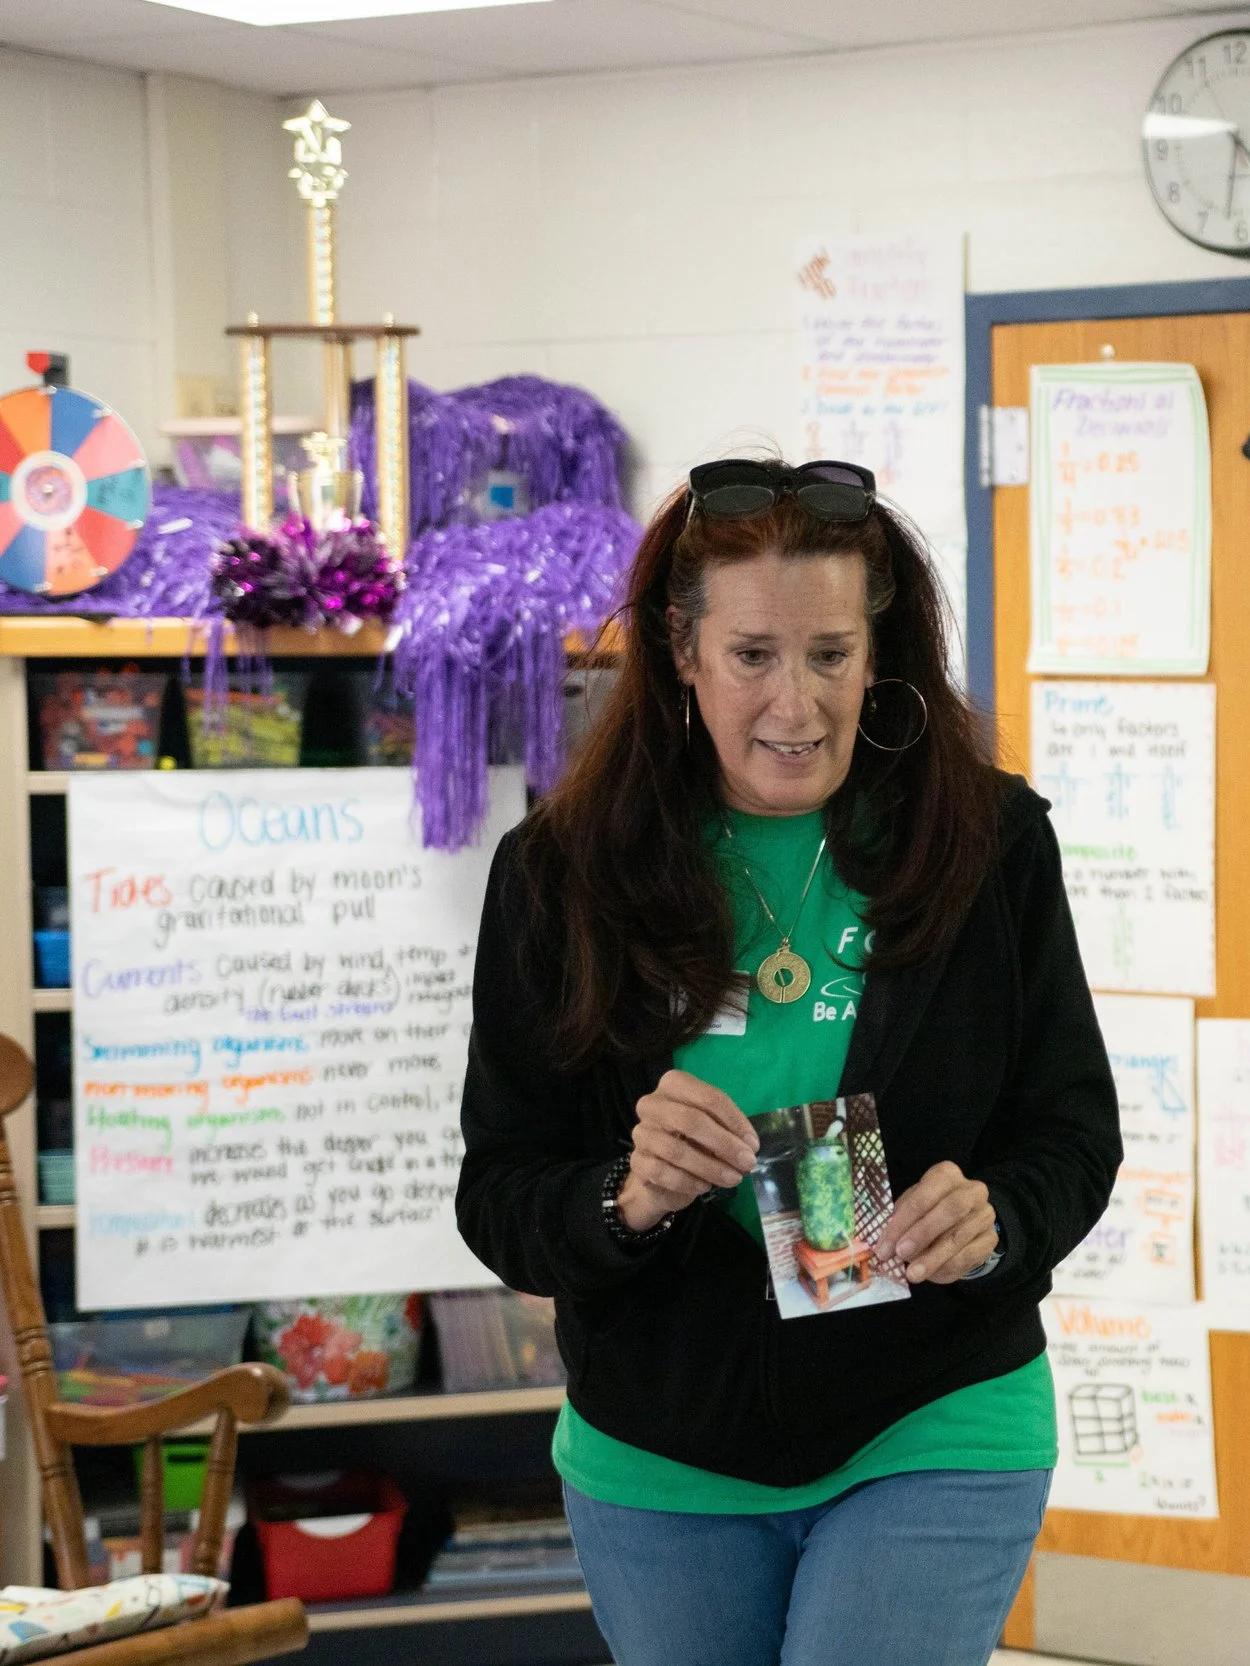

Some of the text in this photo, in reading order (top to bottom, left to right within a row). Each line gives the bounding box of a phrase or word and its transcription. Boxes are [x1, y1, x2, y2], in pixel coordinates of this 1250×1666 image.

[1223, 41, 1248, 65] 12
[1183, 55, 1207, 81] 11
[1155, 139, 1170, 162] 9
[1168, 181, 1182, 205] 8
[1234, 220, 1249, 243] 6
[199, 789, 366, 852] Oceans
[290, 867, 318, 898] by
[331, 896, 376, 934] pull
[303, 952, 326, 980] by
[813, 1001, 837, 1022] Be
